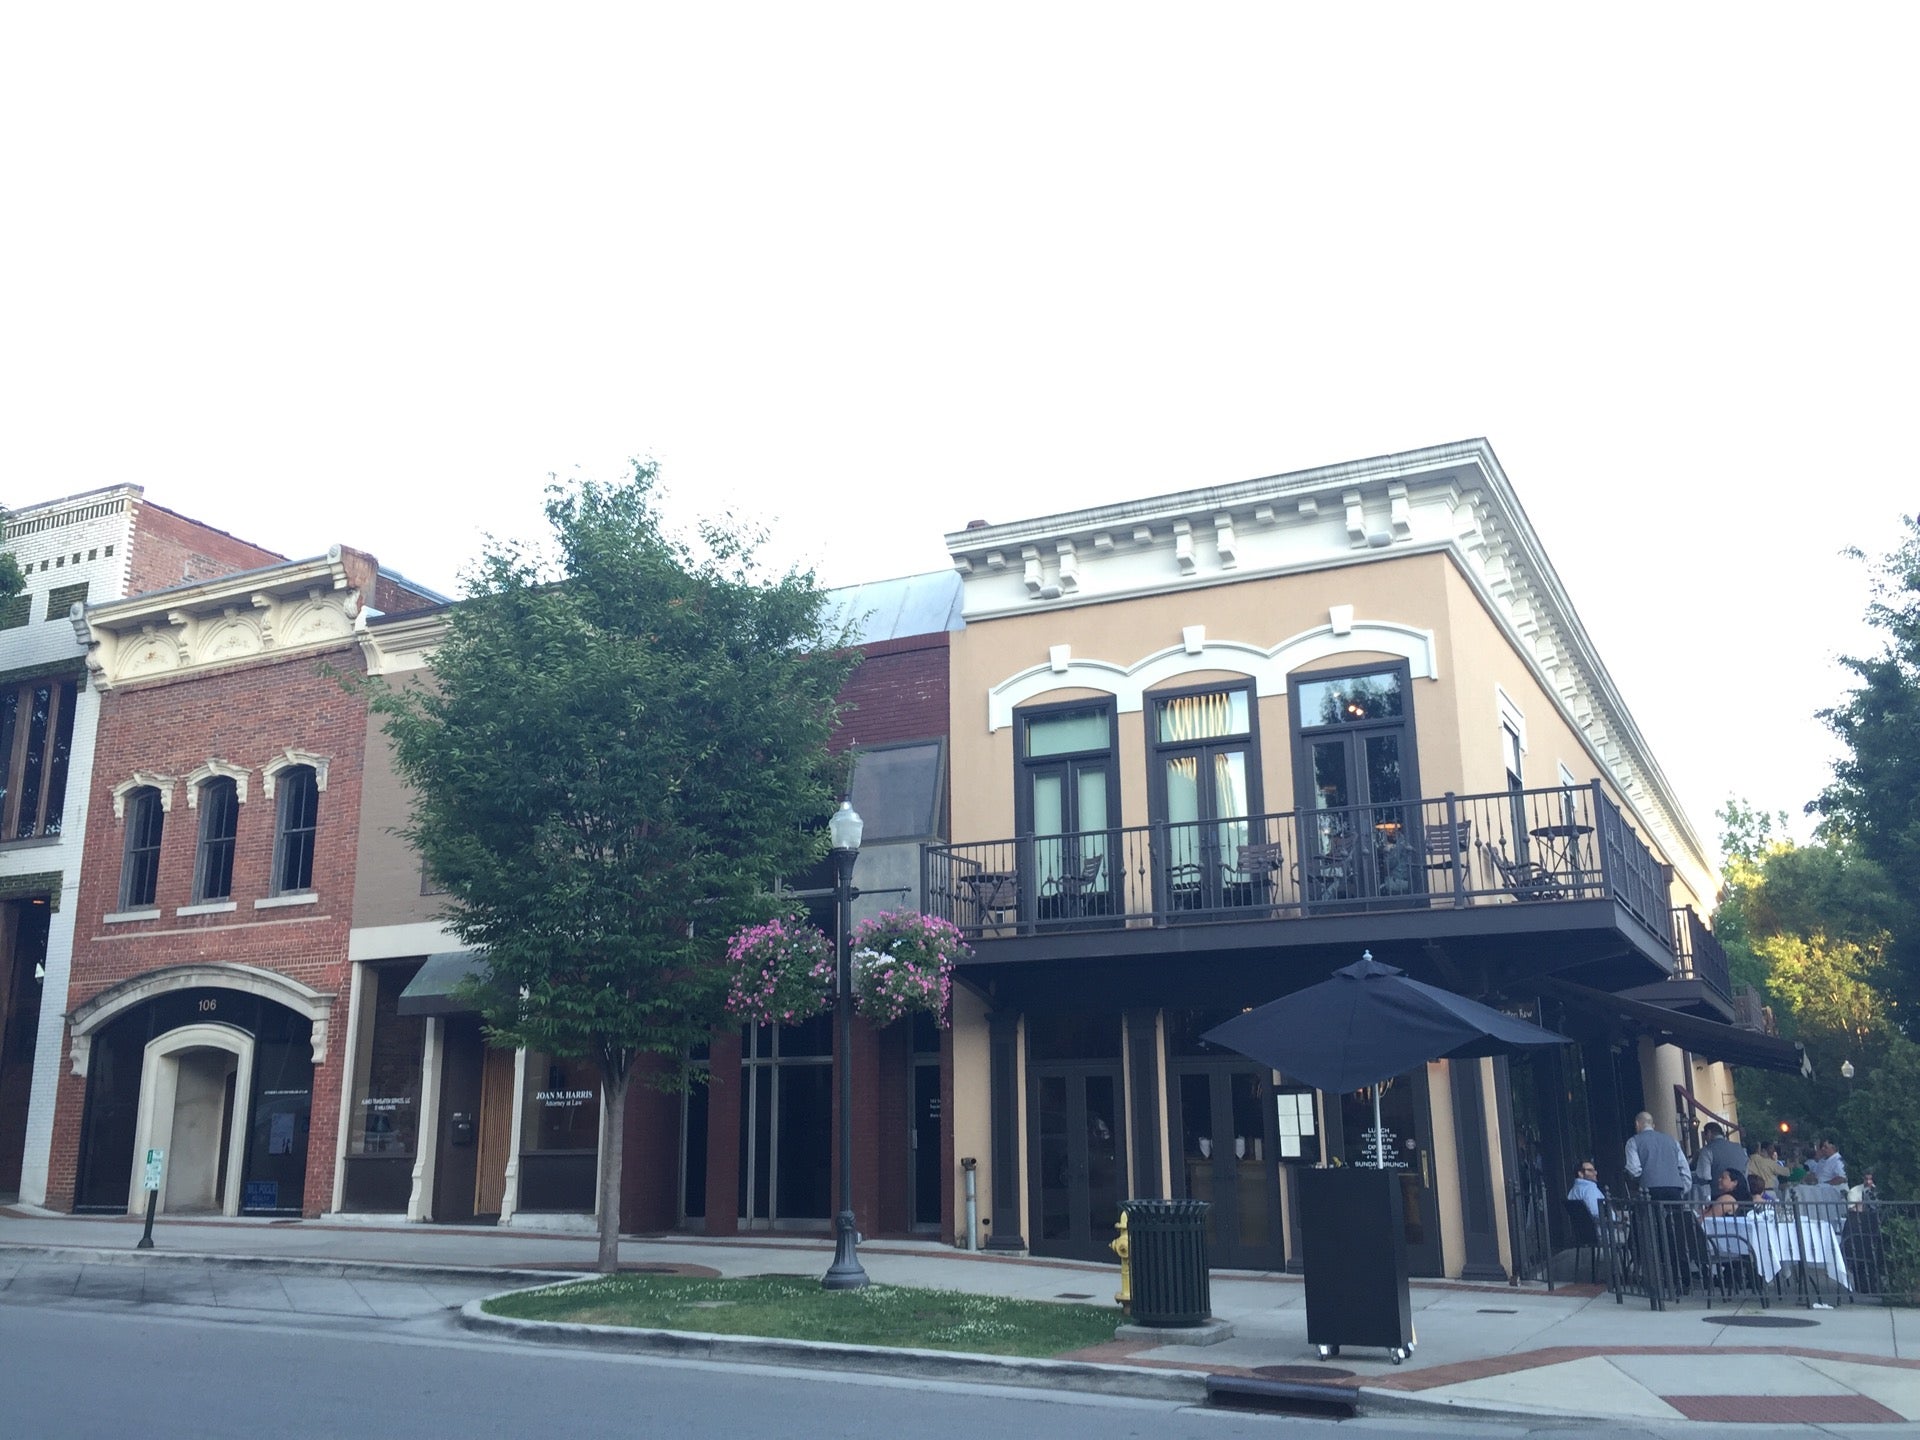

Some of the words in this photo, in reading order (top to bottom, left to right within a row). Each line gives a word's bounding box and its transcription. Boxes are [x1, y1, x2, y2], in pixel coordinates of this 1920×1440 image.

[198, 999, 217, 1011] 106
[536, 1091, 555, 1100] JOAN
[556, 1091, 565, 1099] M.
[566, 1090, 593, 1099] HARRIS
[545, 1100, 565, 1108] Attorney
